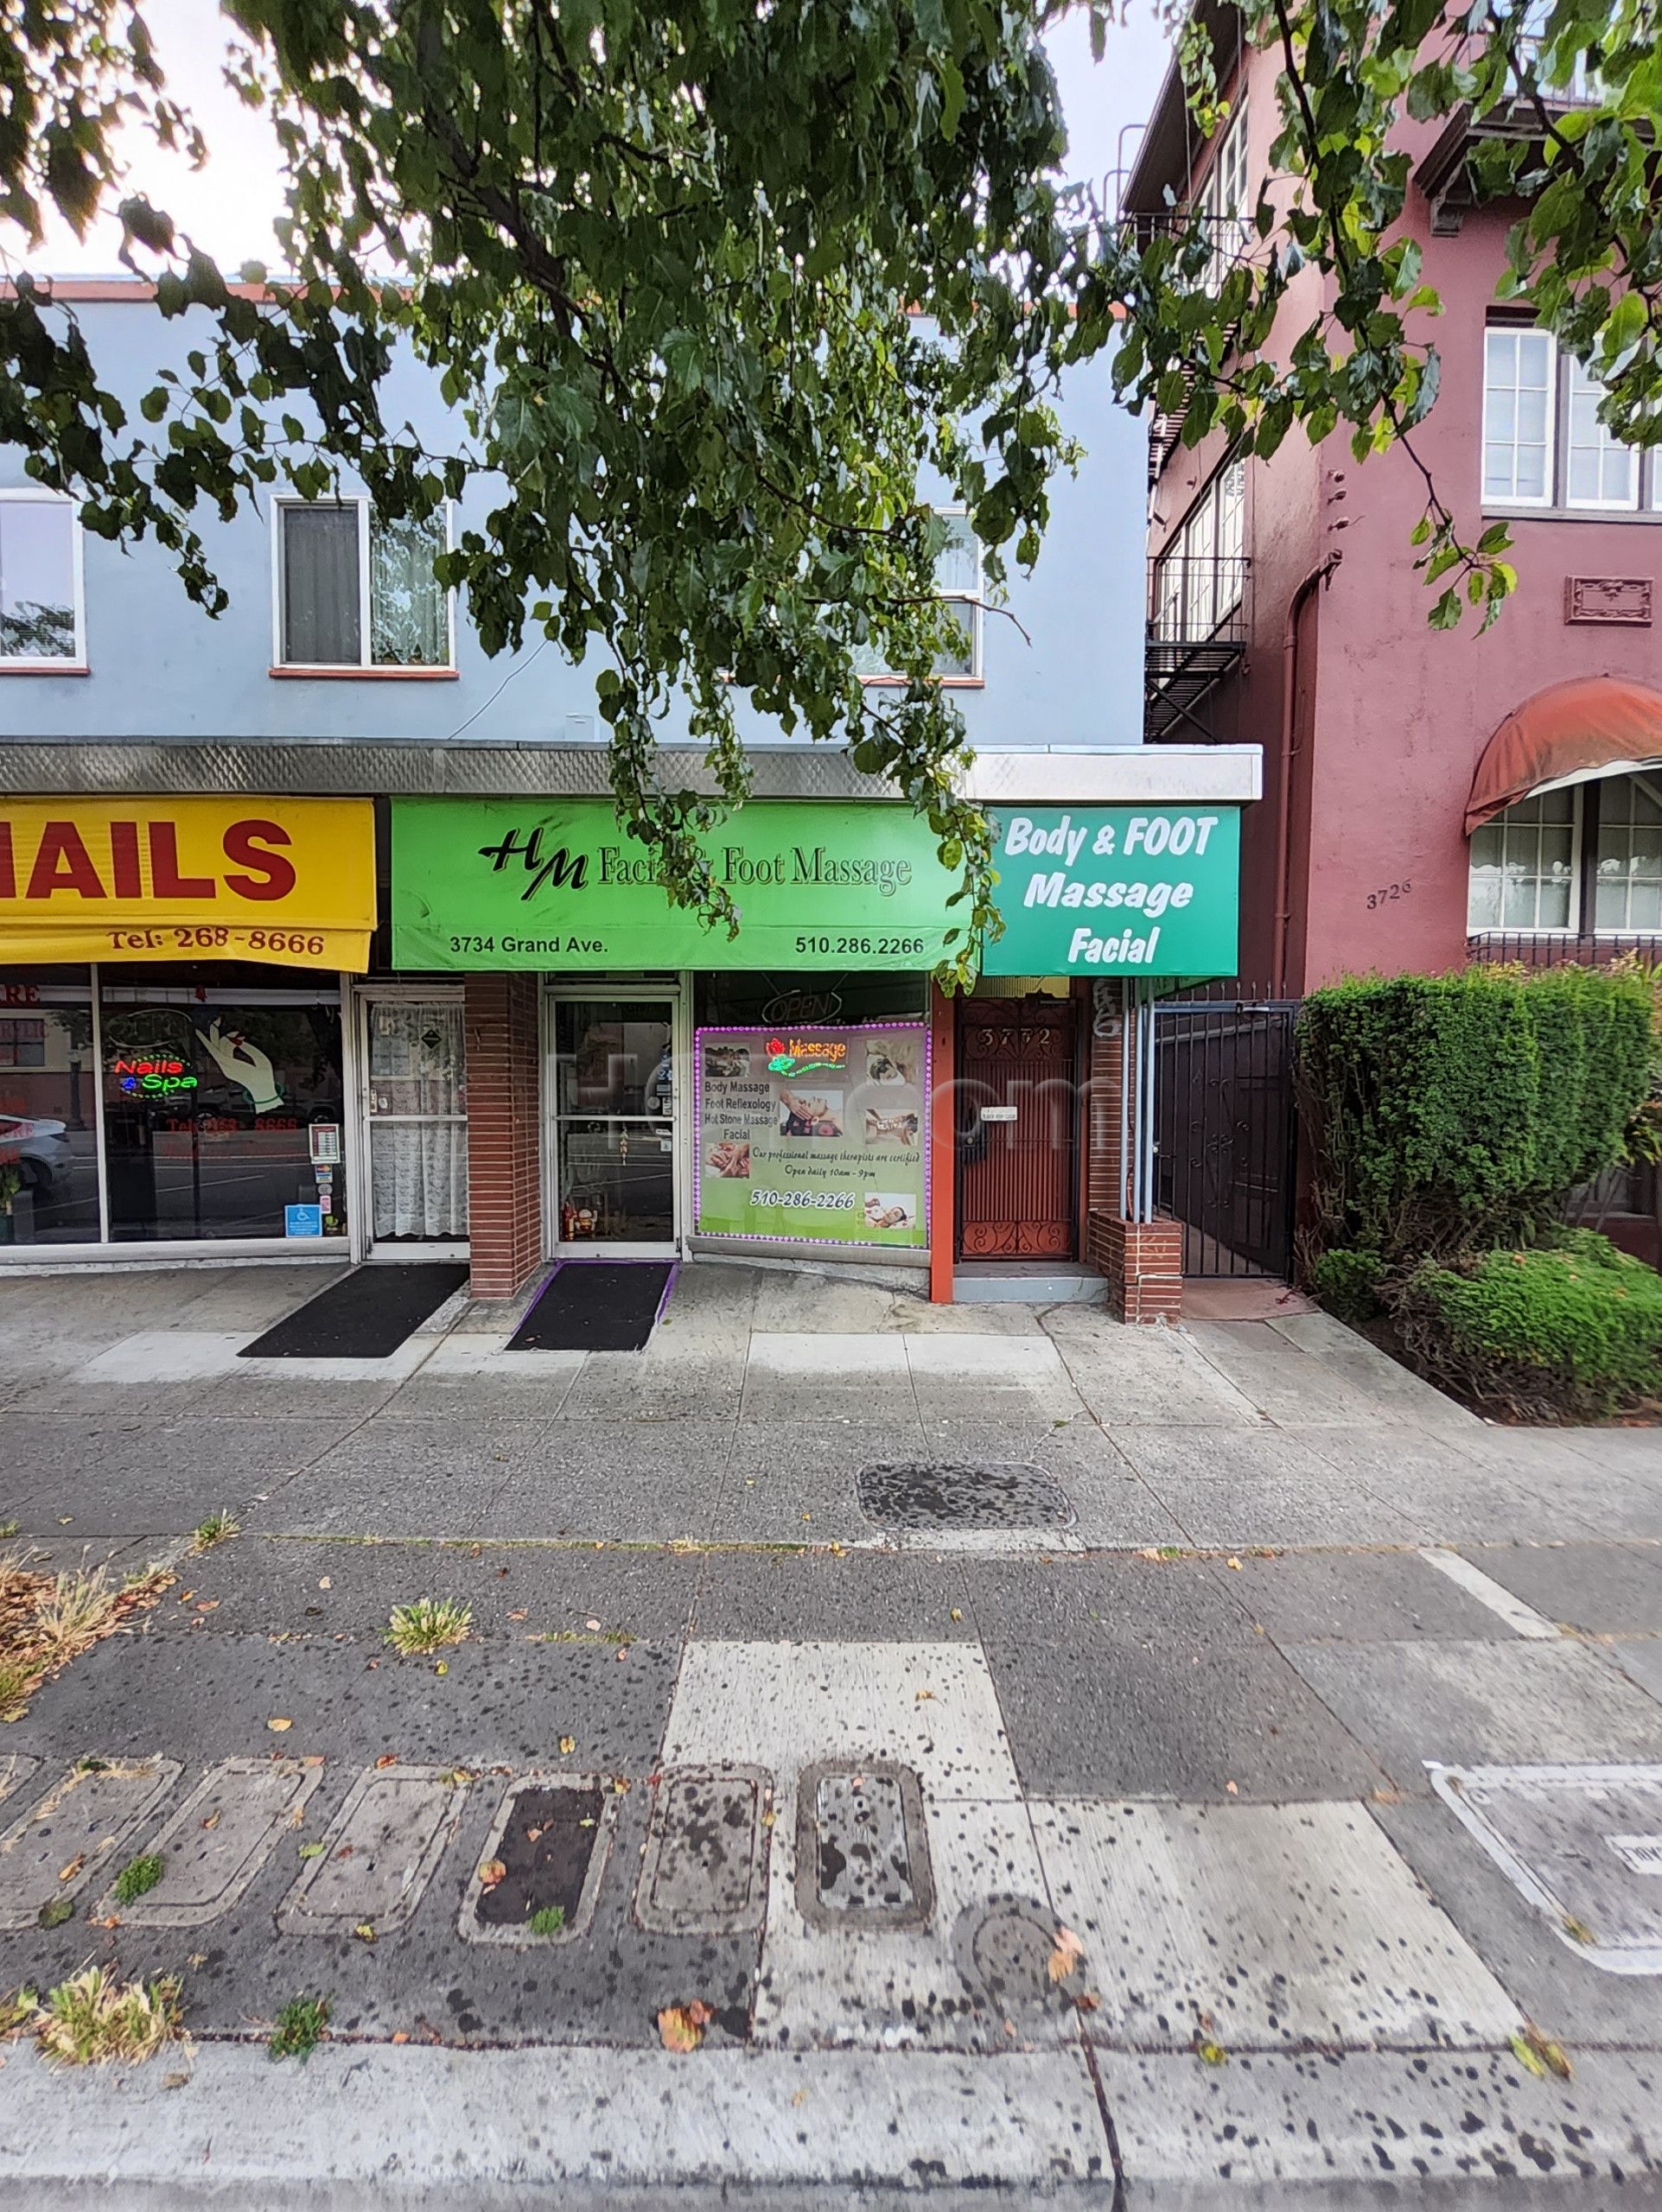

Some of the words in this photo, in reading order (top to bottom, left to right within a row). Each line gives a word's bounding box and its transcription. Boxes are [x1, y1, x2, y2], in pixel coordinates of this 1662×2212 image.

[1004, 815, 1087, 867] Body
[1092, 824, 1116, 855] &
[1123, 817, 1219, 856] FOOT
[598, 846, 679, 884] Facia
[722, 846, 786, 885] Foot
[790, 846, 912, 897] Massage
[1023, 872, 1194, 918] Massage
[1366, 878, 1411, 910] 3726
[107, 930, 164, 950] Tel:
[449, 937, 495, 953] 3734
[501, 937, 560, 953] Grand
[566, 937, 608, 953] Ave.
[795, 937, 924, 954] 510.286.2266
[1067, 926, 1161, 963] Facial
[770, 993, 830, 1023] OPEN
[789, 1039, 845, 1061] Massage
[113, 1059, 184, 1074] Nails
[142, 1073, 198, 1092] Spa
[704, 1081, 728, 1095] Body
[730, 1081, 770, 1095] Massage
[705, 1097, 724, 1109] Foot
[726, 1097, 776, 1112] Reflexology
[704, 1113, 718, 1124] Hot
[719, 1113, 742, 1124] Stone
[743, 1114, 779, 1128] Massage
[723, 1128, 750, 1140] Facial
[768, 1149, 809, 1163] professional
[811, 1152, 838, 1164] massage
[839, 1150, 875, 1165] therapists
[876, 1154, 888, 1163] are
[888, 1152, 920, 1166] certified
[785, 1164, 806, 1179] Open
[807, 1166, 827, 1179] daily
[830, 1168, 850, 1177] 10am
[858, 1170, 876, 1180] 9pm
[750, 1190, 856, 1210] 510-286-2266
